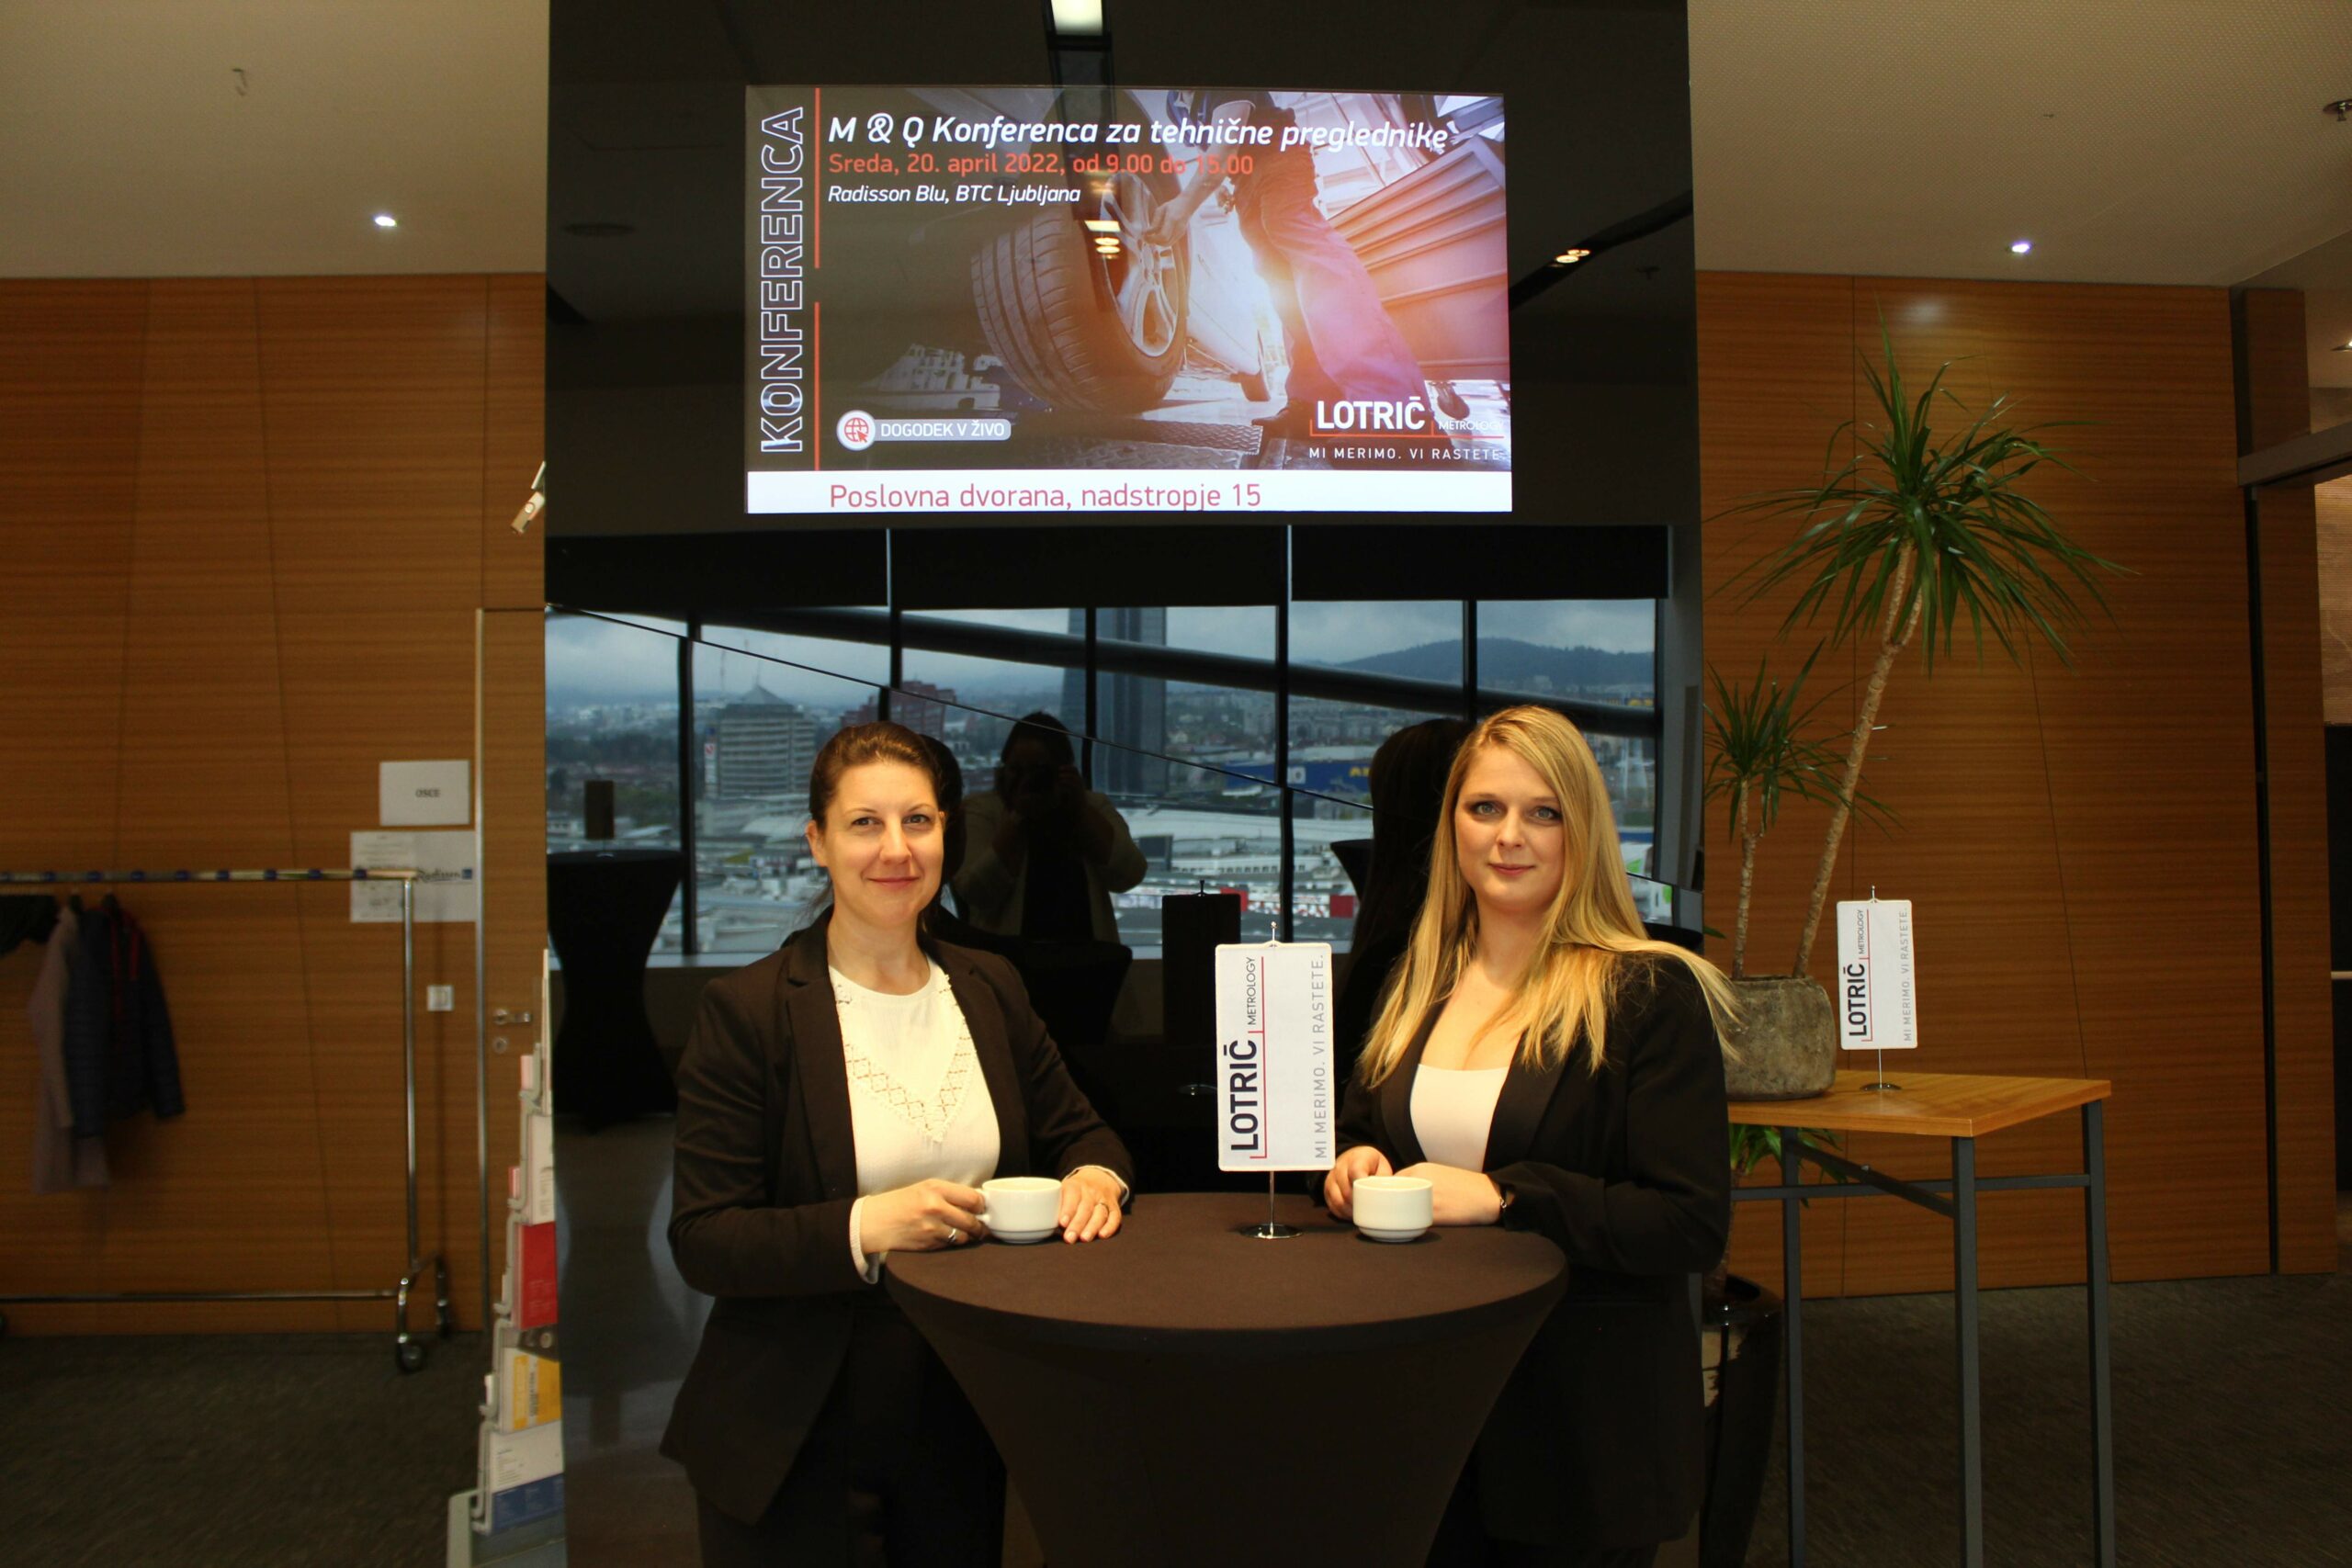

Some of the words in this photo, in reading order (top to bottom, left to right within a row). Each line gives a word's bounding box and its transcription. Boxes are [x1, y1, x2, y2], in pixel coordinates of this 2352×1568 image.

[828, 117, 857, 142] M
[866, 113, 894, 143] &
[902, 116, 925, 148] Q
[933, 115, 1097, 149] Konferenca
[1105, 122, 1140, 144] za
[1150, 118, 1273, 145] tehnične
[1281, 120, 1448, 152] preglednike
[829, 153, 899, 175] Sreda,
[907, 153, 940, 173] 20.
[948, 152, 997, 178] april
[1005, 153, 1066, 175] 2022,
[1073, 152, 1100, 173] od
[1106, 154, 1153, 174] 9.00
[1160, 153, 1185, 175] do
[1196, 155, 1253, 175] 15.00
[828, 185, 910, 203] Radisson
[915, 185, 950, 205] Blu,
[956, 185, 993, 202] BTC
[997, 185, 1081, 207] Ljubljana
[761, 107, 804, 452] KONFERENCA
[880, 423, 953, 437] DOGODEK
[956, 423, 968, 437] V
[971, 419, 1005, 437] ŽIVO
[1439, 420, 1504, 432] METROLOGY
[1309, 447, 1326, 459] MI
[1334, 447, 1402, 459] MERIMO.
[1409, 447, 1424, 459] VI
[831, 483, 950, 508] Poslovna
[959, 483, 1072, 511] dvorana,
[1081, 482, 1221, 511] nadstropje
[1233, 483, 1261, 506] 15
[1857, 909, 1865, 954] METROLOGY
[1901, 964, 1909, 975] VI
[1246, 956, 1257, 1026] METROLOGY
[1311, 954, 1325, 1033] RASTETE.
[1904, 1029, 1911, 1042] MI
[1313, 1041, 1325, 1055] VI
[1314, 1062, 1327, 1134] MERIMO.
[1315, 1141, 1328, 1159] MI
